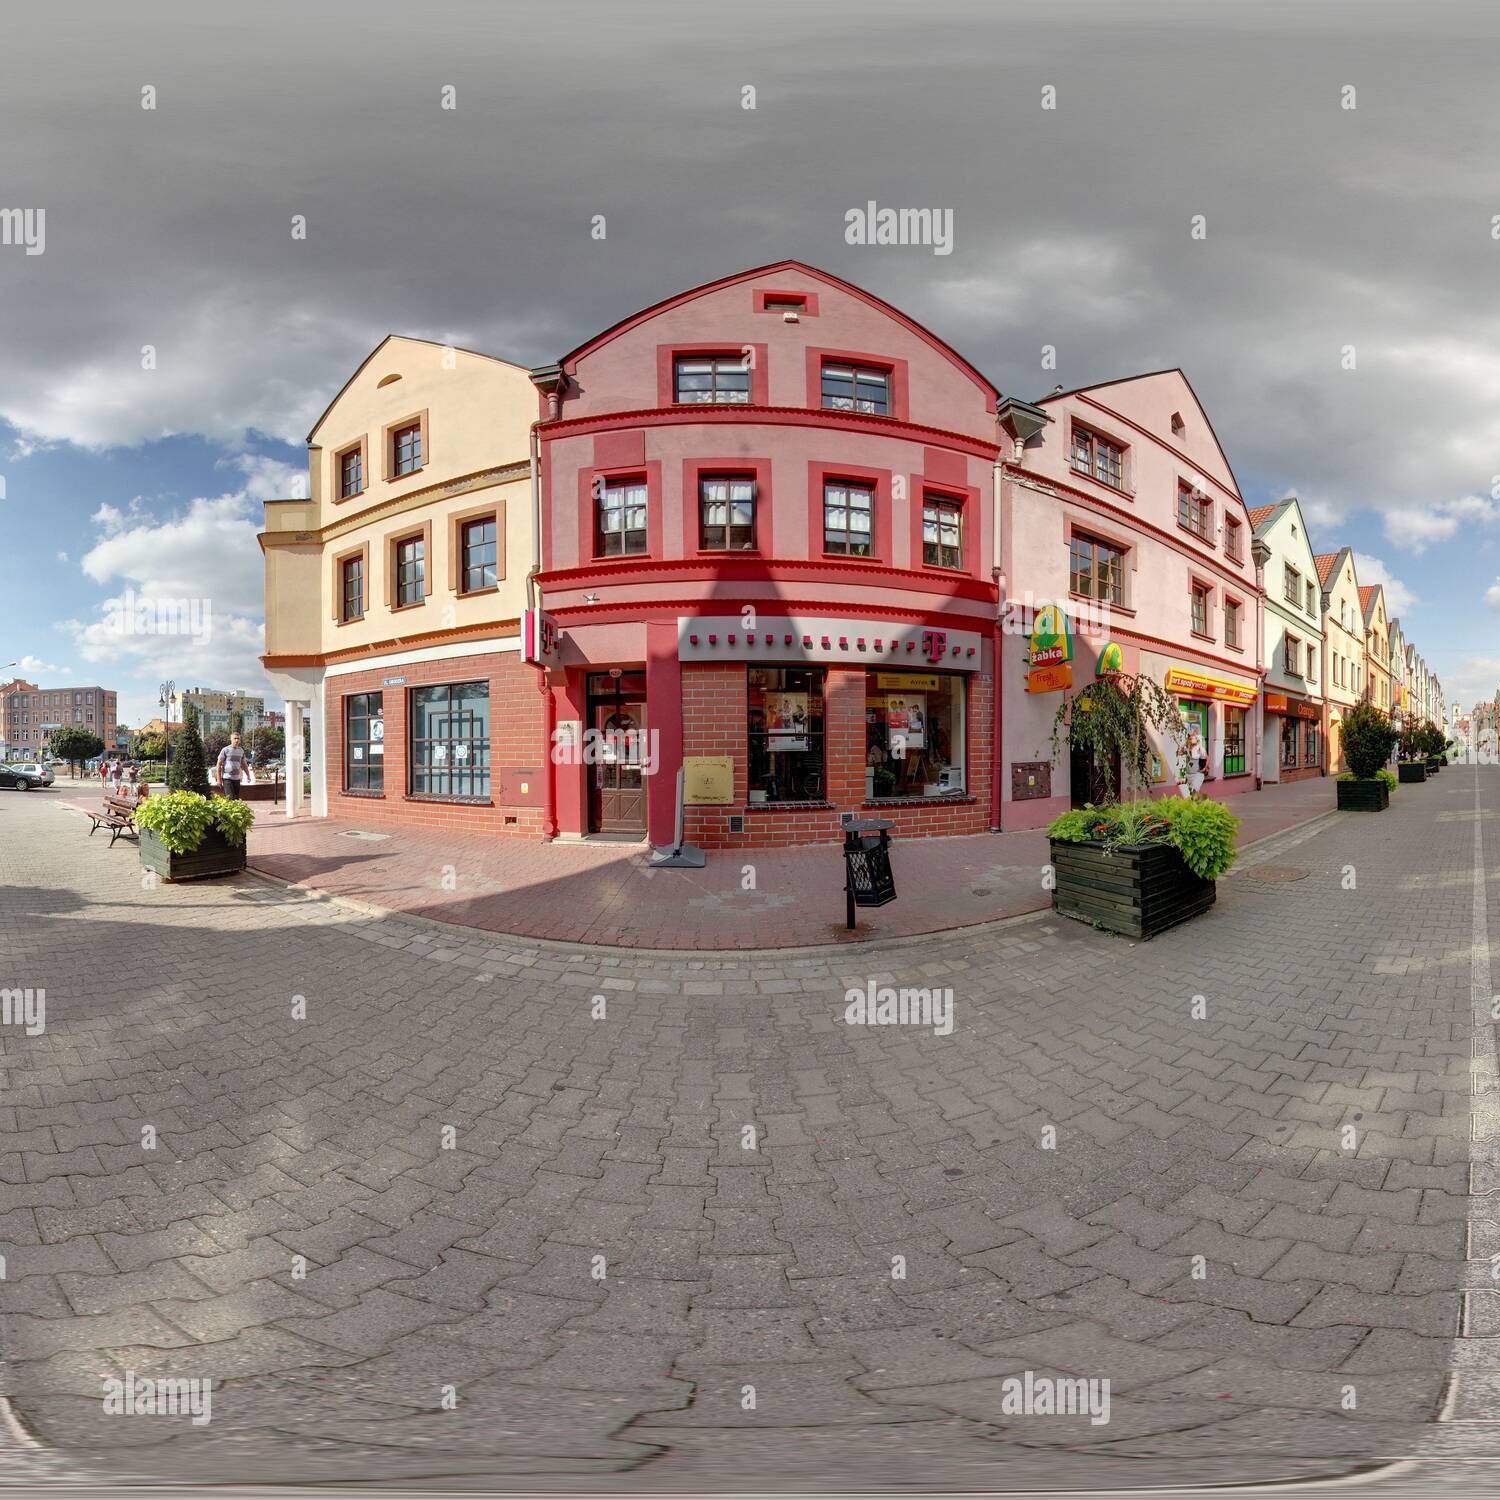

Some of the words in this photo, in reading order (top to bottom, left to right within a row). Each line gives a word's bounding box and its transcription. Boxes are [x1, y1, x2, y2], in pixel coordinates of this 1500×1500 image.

[1032, 648, 1063, 662] żabka
[1036, 671, 1055, 682] Fresh
[1297, 703, 1314, 718] Orange
